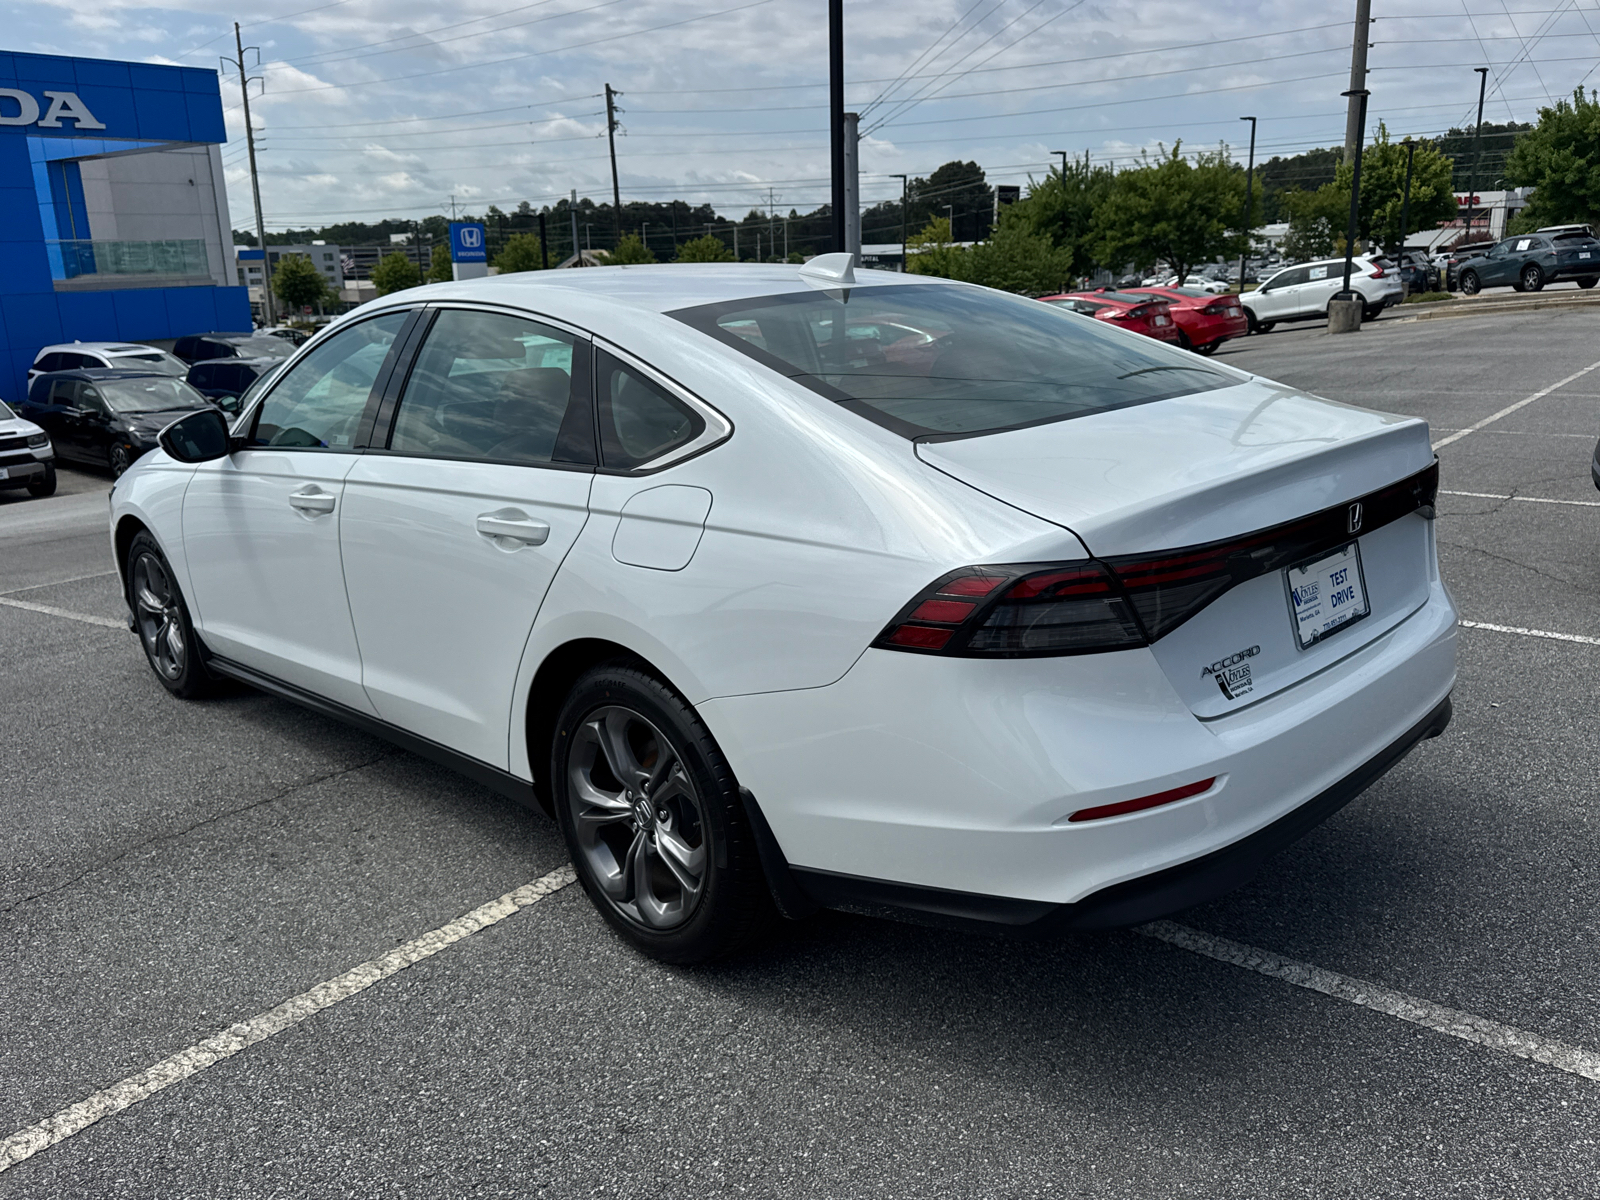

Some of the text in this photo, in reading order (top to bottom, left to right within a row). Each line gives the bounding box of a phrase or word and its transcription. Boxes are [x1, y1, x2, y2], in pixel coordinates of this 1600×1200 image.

[1330, 568, 1348, 587] TEST
[1295, 584, 1319, 604] VOYLES
[1331, 586, 1355, 608] DRIVE
[1201, 645, 1261, 678] ACCORD
[1222, 665, 1251, 688] VOYLES
